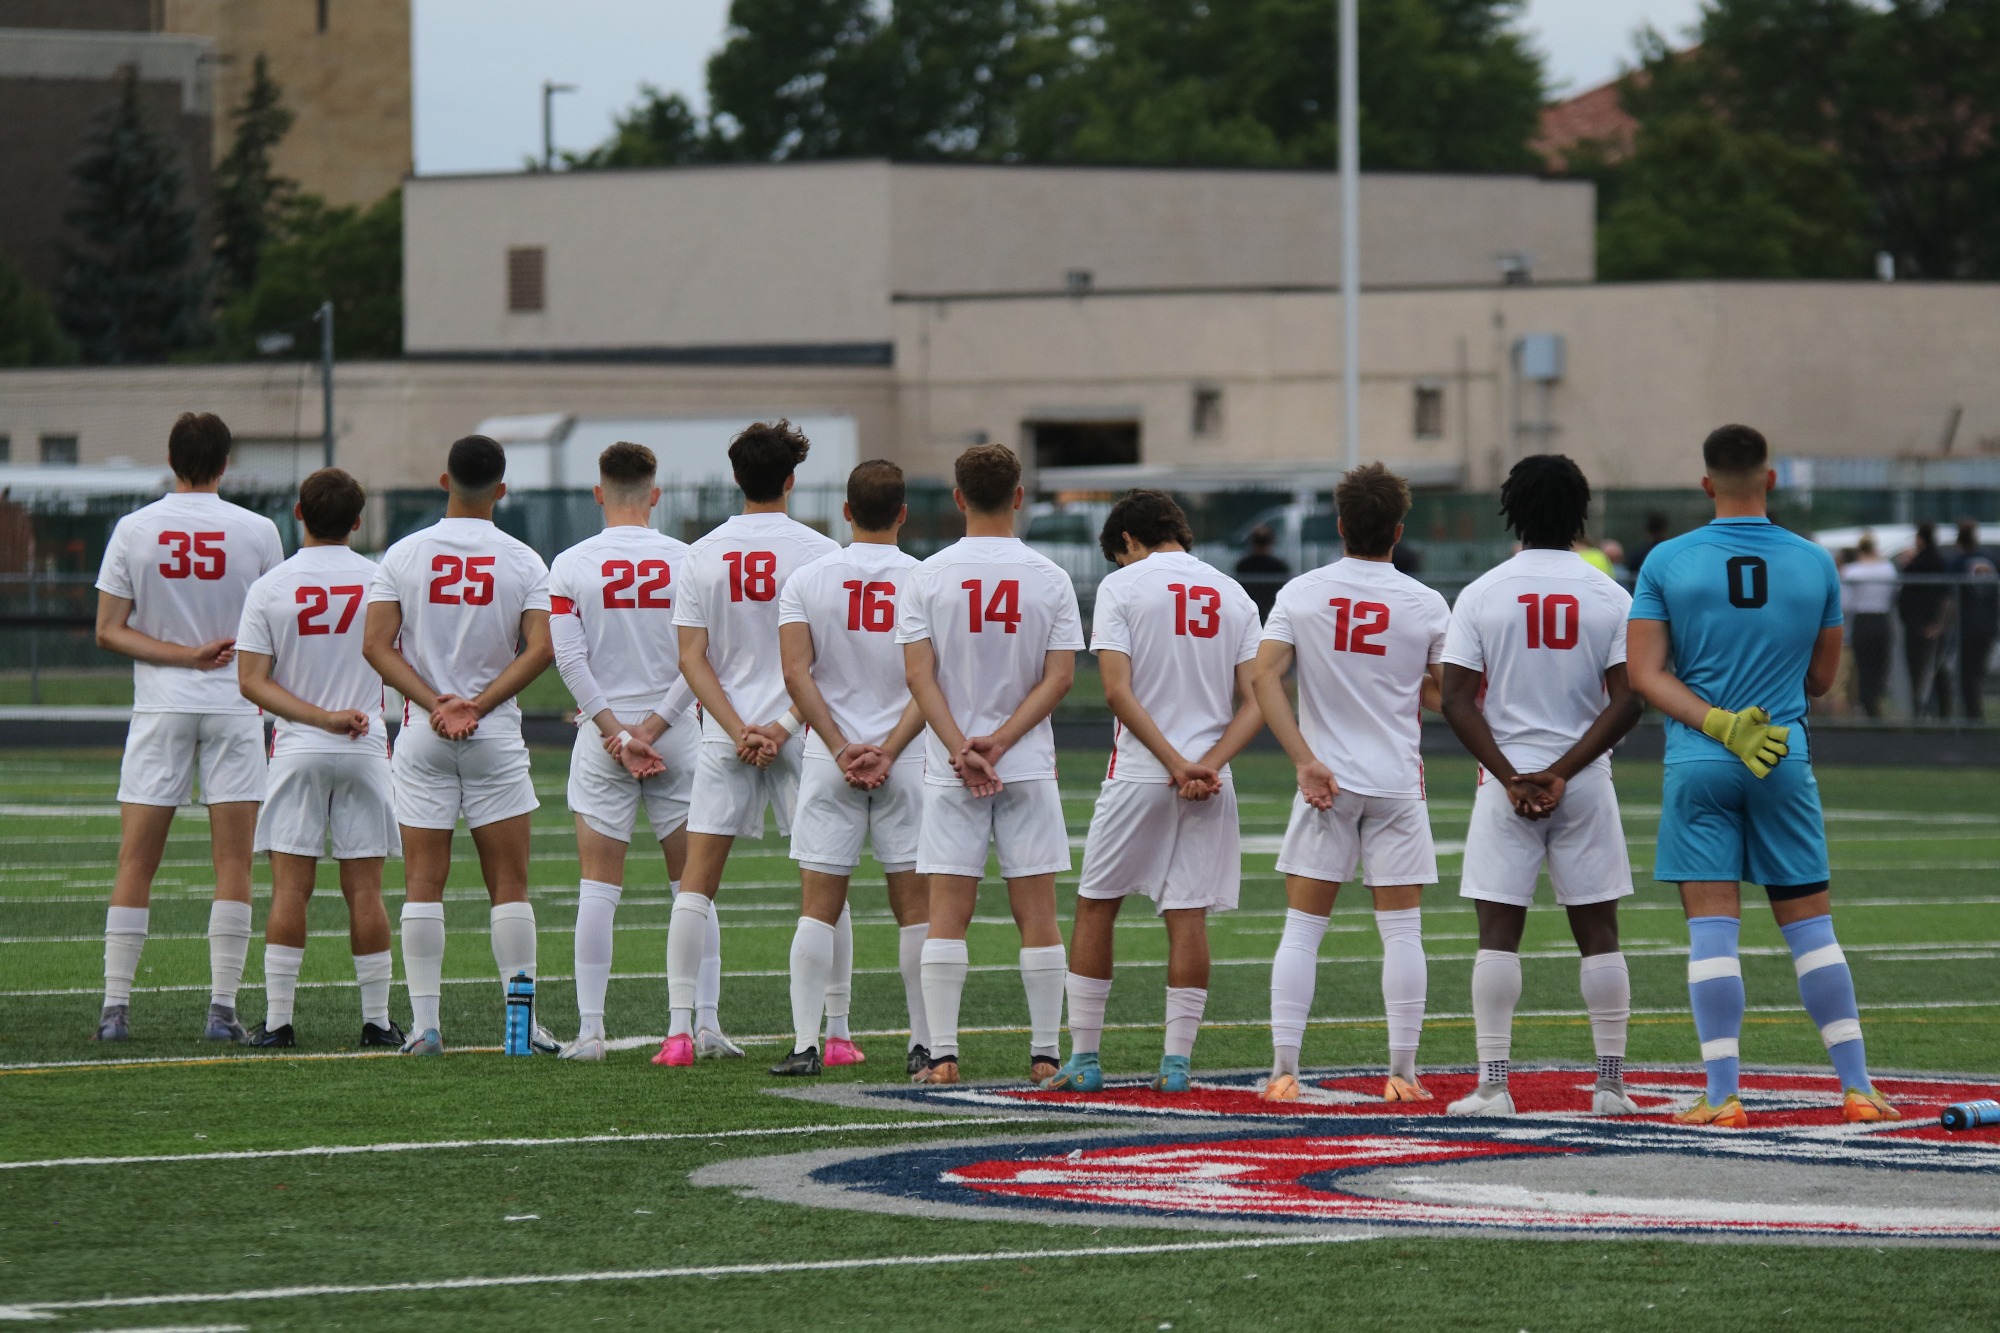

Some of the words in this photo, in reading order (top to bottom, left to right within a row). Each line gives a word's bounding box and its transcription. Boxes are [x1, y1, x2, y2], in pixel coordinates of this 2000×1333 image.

[159, 531, 225, 579] 35
[430, 555, 495, 605] 25
[723, 552, 776, 602] 18
[602, 560, 670, 608] 22
[844, 580, 895, 632] 16
[962, 580, 1021, 633] 14
[1727, 556, 1768, 609] 0
[296, 585, 363, 635] 27
[1168, 584, 1220, 638] 13
[1330, 598, 1389, 655] 12
[1519, 594, 1579, 649] 10
